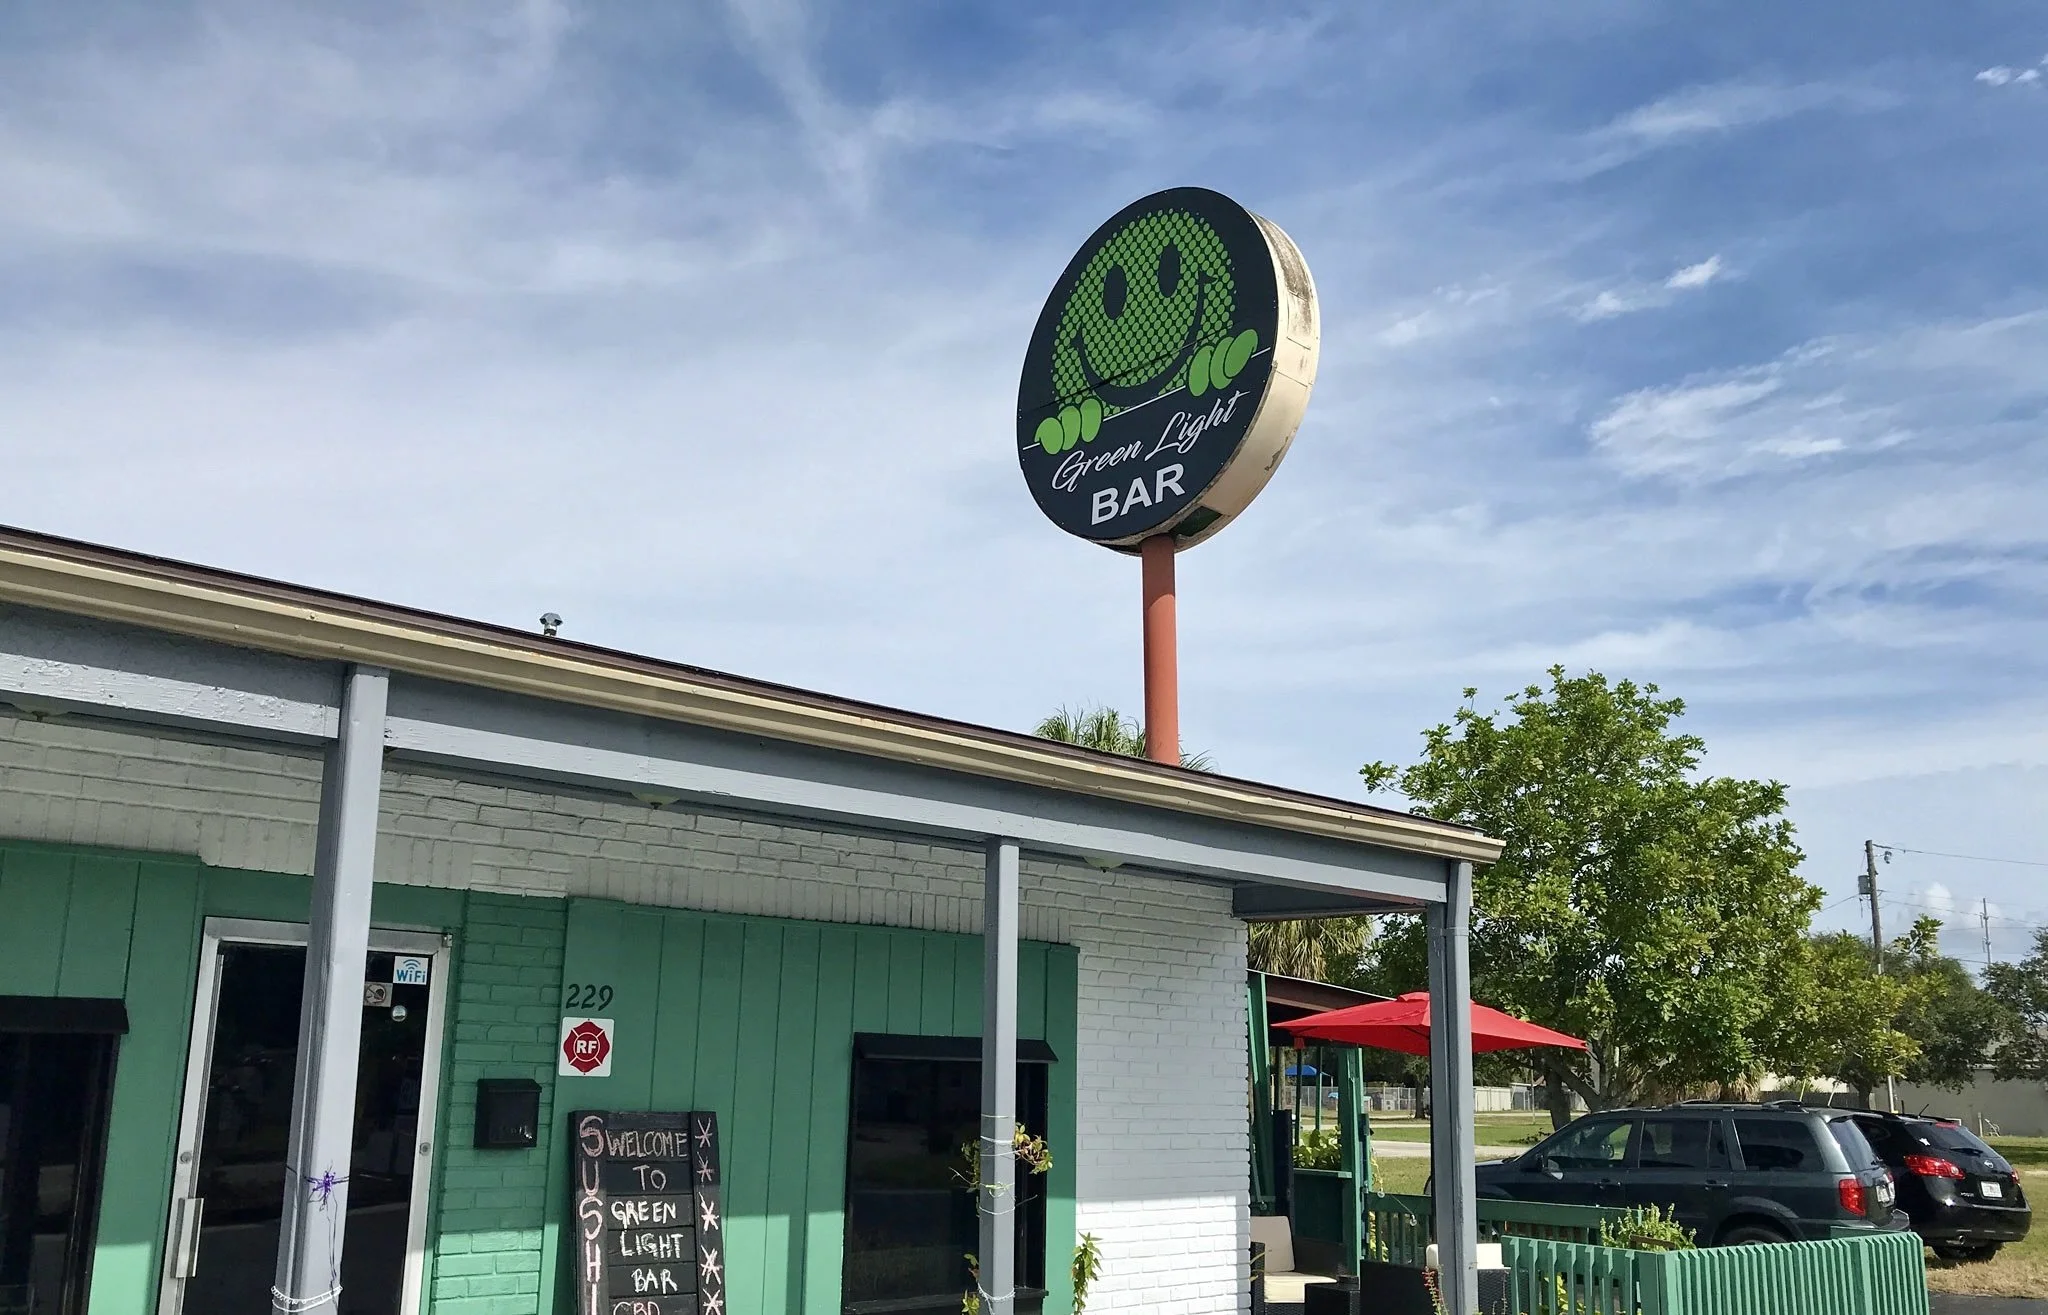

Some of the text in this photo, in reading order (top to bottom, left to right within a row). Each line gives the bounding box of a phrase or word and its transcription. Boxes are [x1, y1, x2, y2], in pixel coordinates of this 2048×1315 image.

[1052, 390, 1250, 492] Green Light
[1091, 463, 1185, 525] BAR
[396, 969, 426, 983] WiFi
[566, 983, 614, 1011] 229
[576, 1040, 597, 1054] RF
[605, 1130, 688, 1158] WELCOME
[633, 1164, 667, 1191] TO
[611, 1200, 677, 1229] GREEN
[619, 1231, 684, 1259] LIGHT
[631, 1268, 678, 1294] BAR
